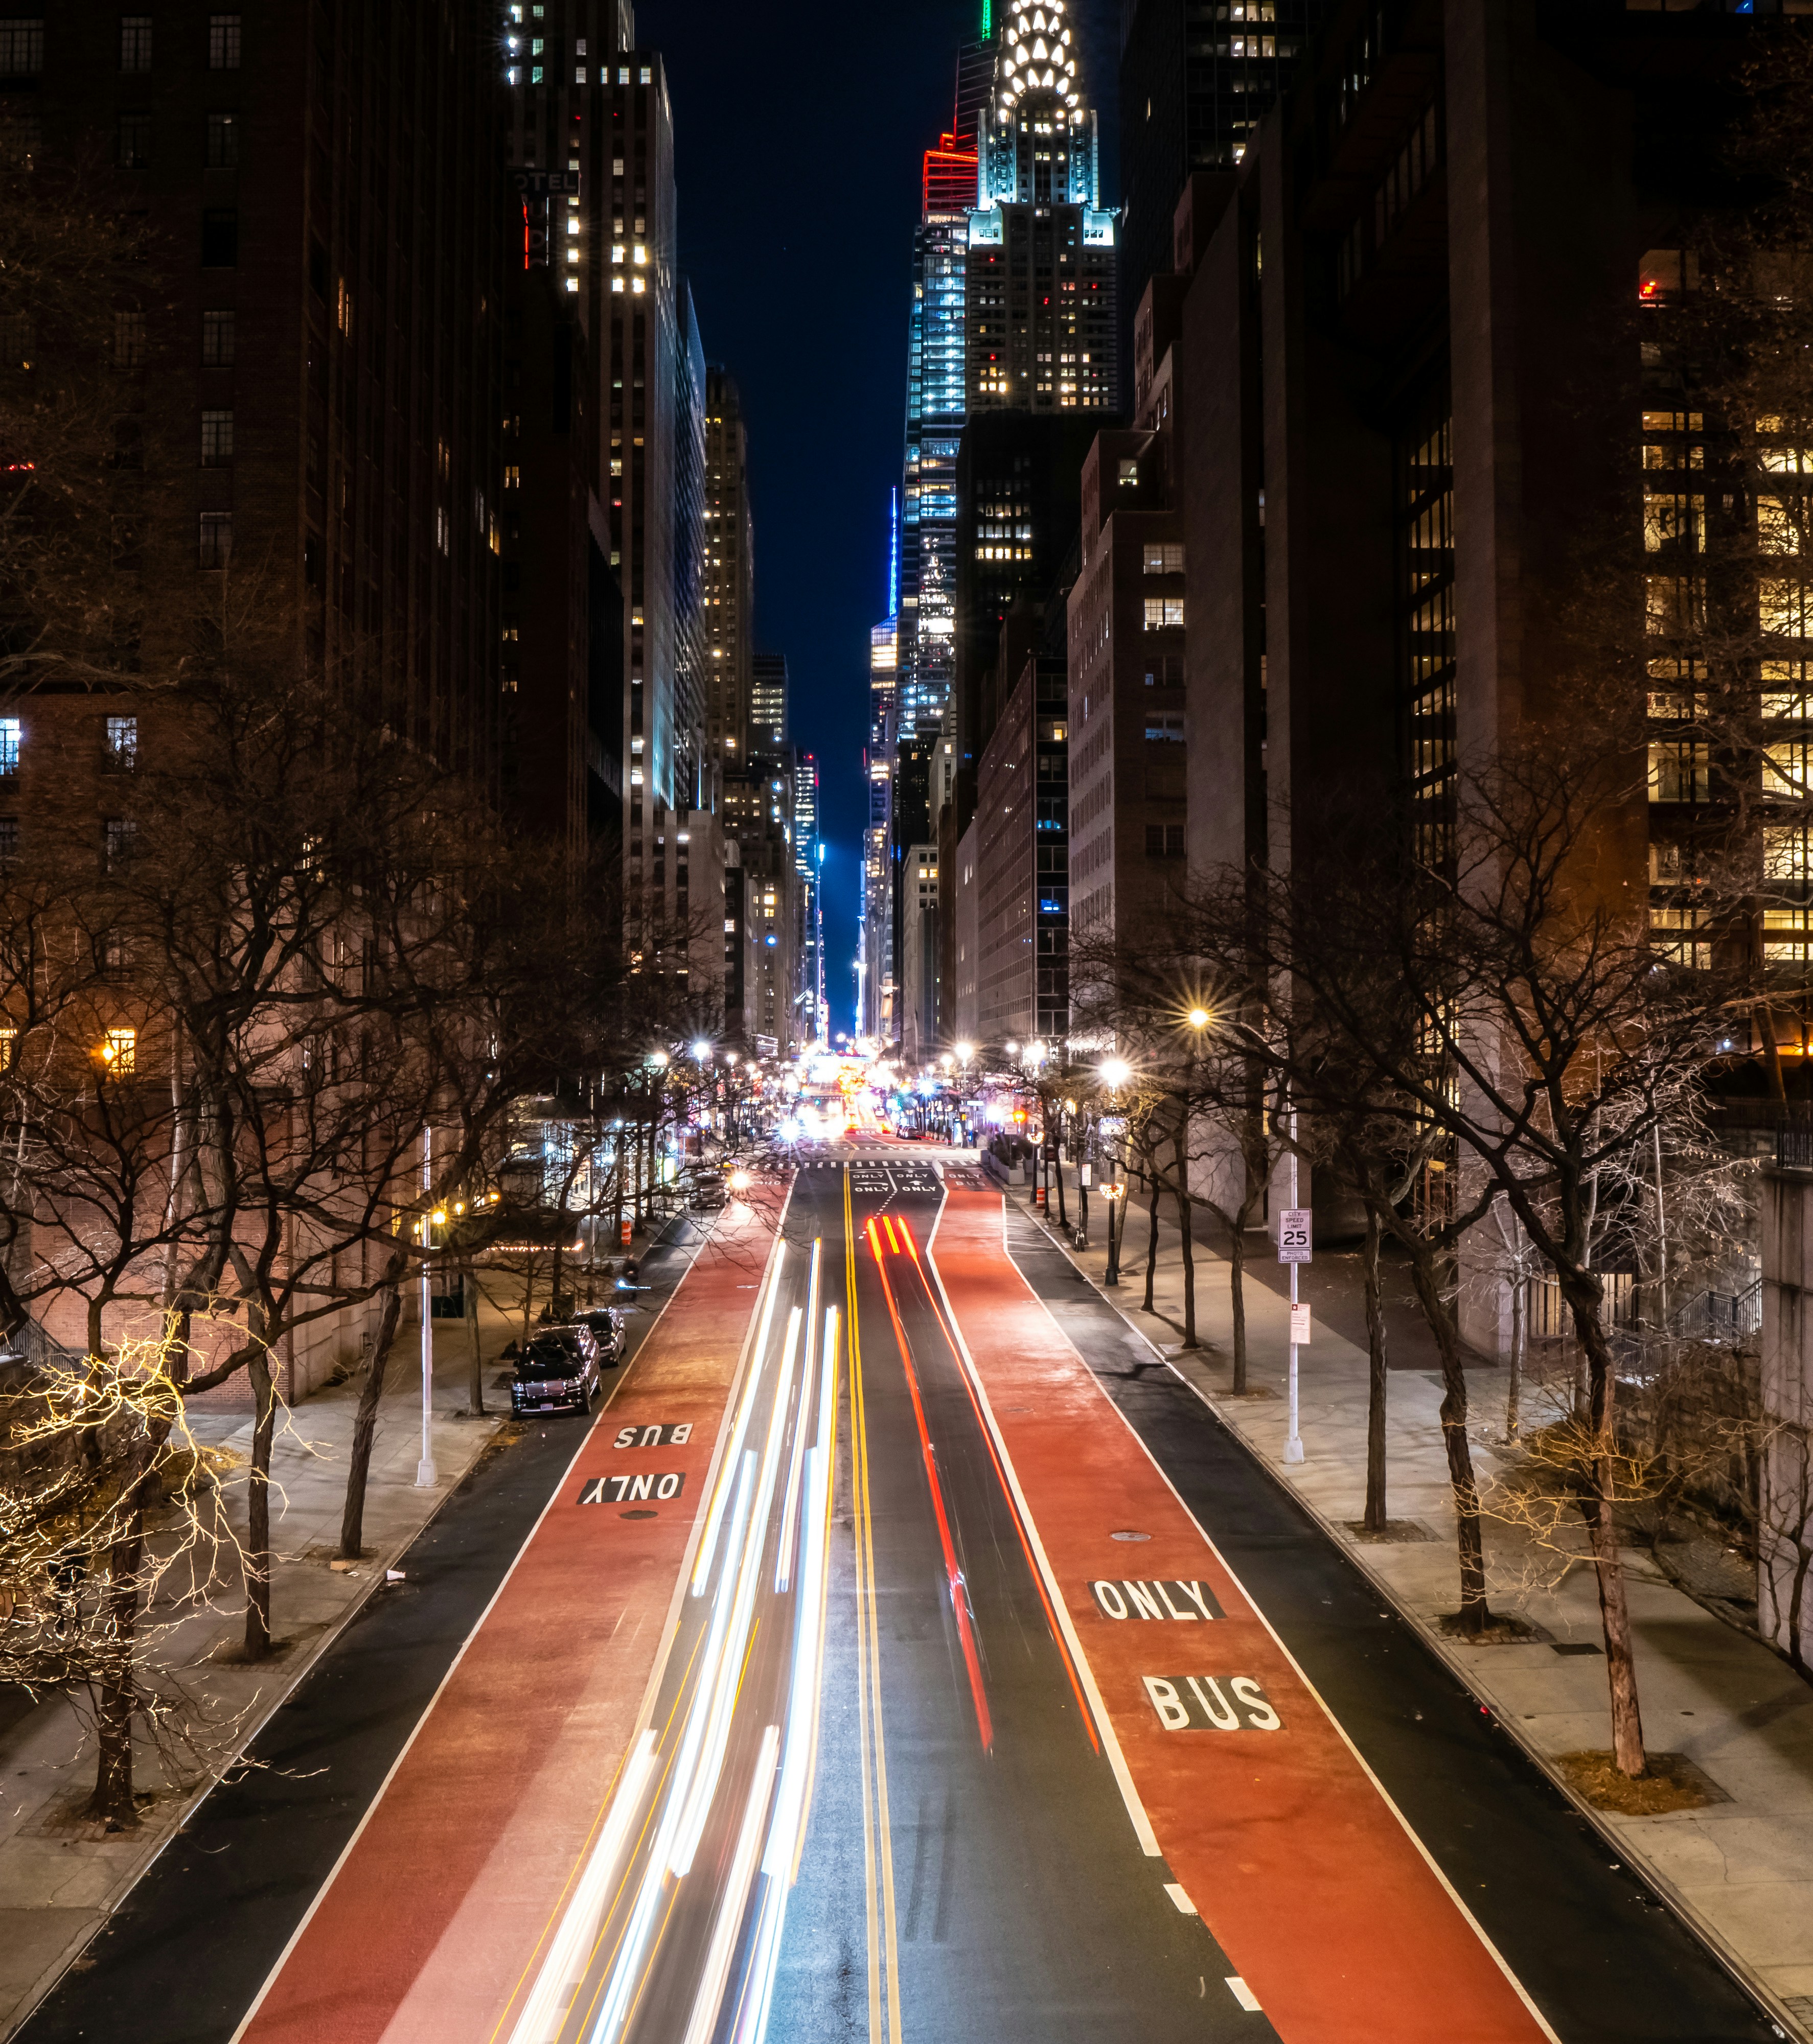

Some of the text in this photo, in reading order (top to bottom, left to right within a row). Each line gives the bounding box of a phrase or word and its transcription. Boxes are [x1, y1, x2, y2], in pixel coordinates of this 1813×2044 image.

[514, 172, 576, 191] OTEL
[1283, 1231, 1307, 1245] 25
[613, 1423, 694, 1449] BUS
[582, 1473, 679, 1504] ONLY
[1094, 1580, 1213, 1620] ONLY
[1141, 1676, 1281, 1730] BUS
